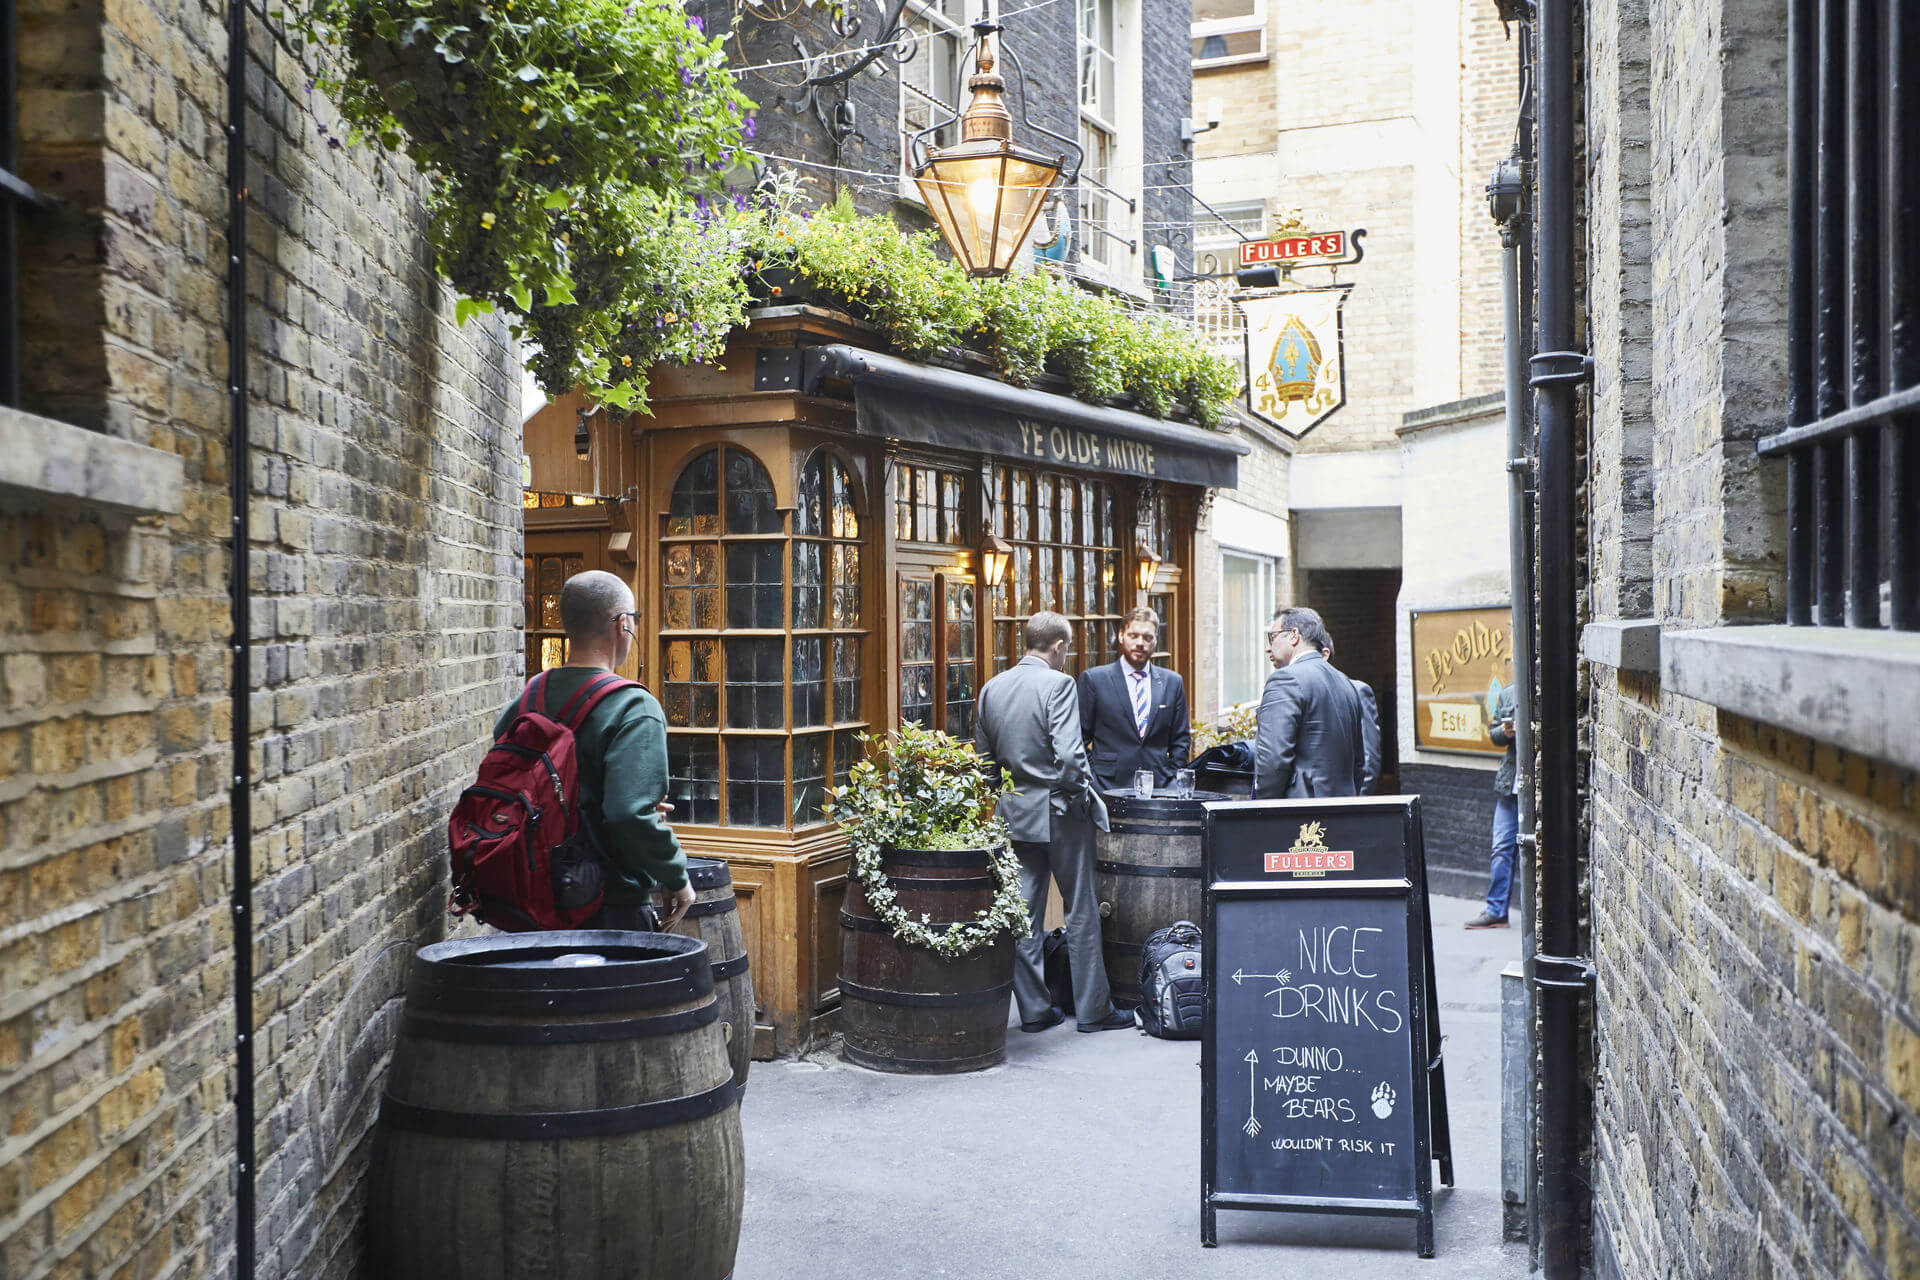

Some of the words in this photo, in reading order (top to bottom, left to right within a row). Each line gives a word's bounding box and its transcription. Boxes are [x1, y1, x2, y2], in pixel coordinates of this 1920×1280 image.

[1245, 235, 1337, 261] FULLER'S
[1017, 419, 1044, 457] YE
[1050, 426, 1100, 466] OLDE
[1107, 437, 1156, 475] MITRE
[1425, 648, 1454, 696] Ye
[1454, 619, 1503, 665] Olde
[1271, 854, 1347, 869] FULLER'S
[1299, 926, 1383, 978] NICE
[1263, 984, 1402, 1033] DRINKS
[1264, 1075, 1322, 1095] MAYBE
[1271, 1136, 1333, 1151] WOULDN'T
[1338, 1139, 1374, 1154] RISK
[1380, 1142, 1396, 1156] IT
